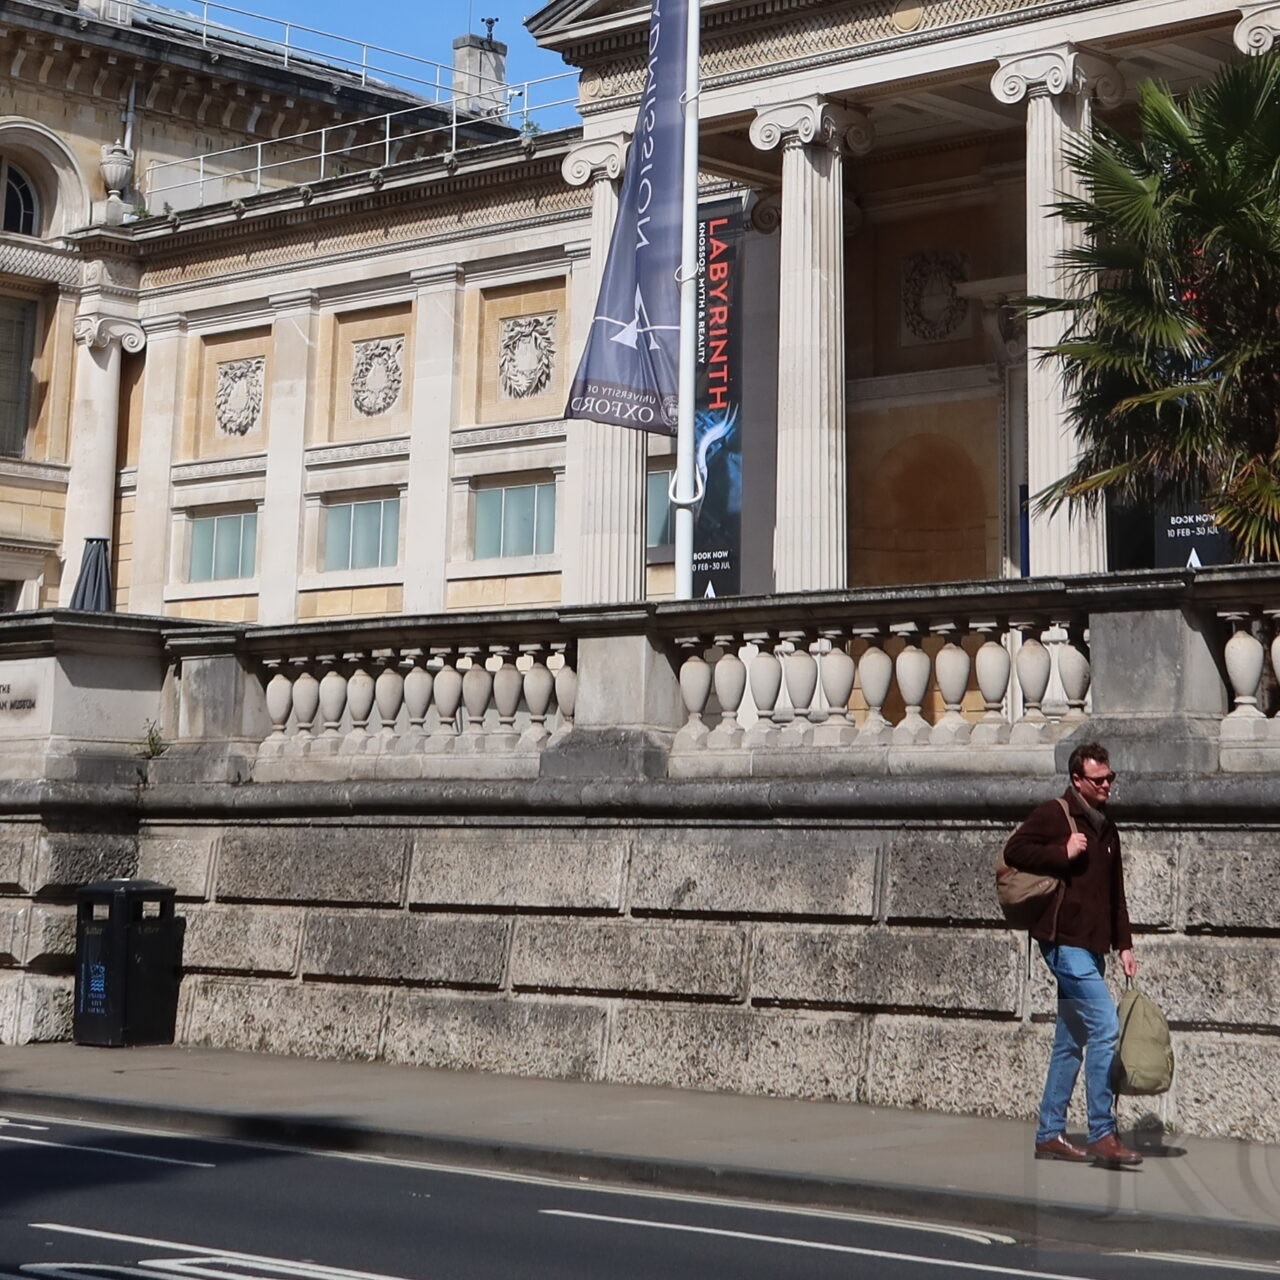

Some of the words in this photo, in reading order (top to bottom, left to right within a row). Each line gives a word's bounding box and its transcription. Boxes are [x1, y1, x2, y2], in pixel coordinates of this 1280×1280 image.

[698, 222, 706, 276] KNOSSOS,
[698, 310, 705, 318] &
[706, 217, 729, 410] LABYRINTH
[1170, 515, 1194, 525] BOOK
[1195, 513, 1216, 523] NOW
[1167, 528, 1175, 538] 10
[1176, 527, 1191, 537] FEB
[1196, 526, 1206, 536] 30
[693, 552, 711, 560] BOOK
[712, 550, 728, 559] NOW
[698, 562, 708, 571] FEB
[721, 561, 731, 570] JUL
[9, 698, 36, 710] MUSEUM
